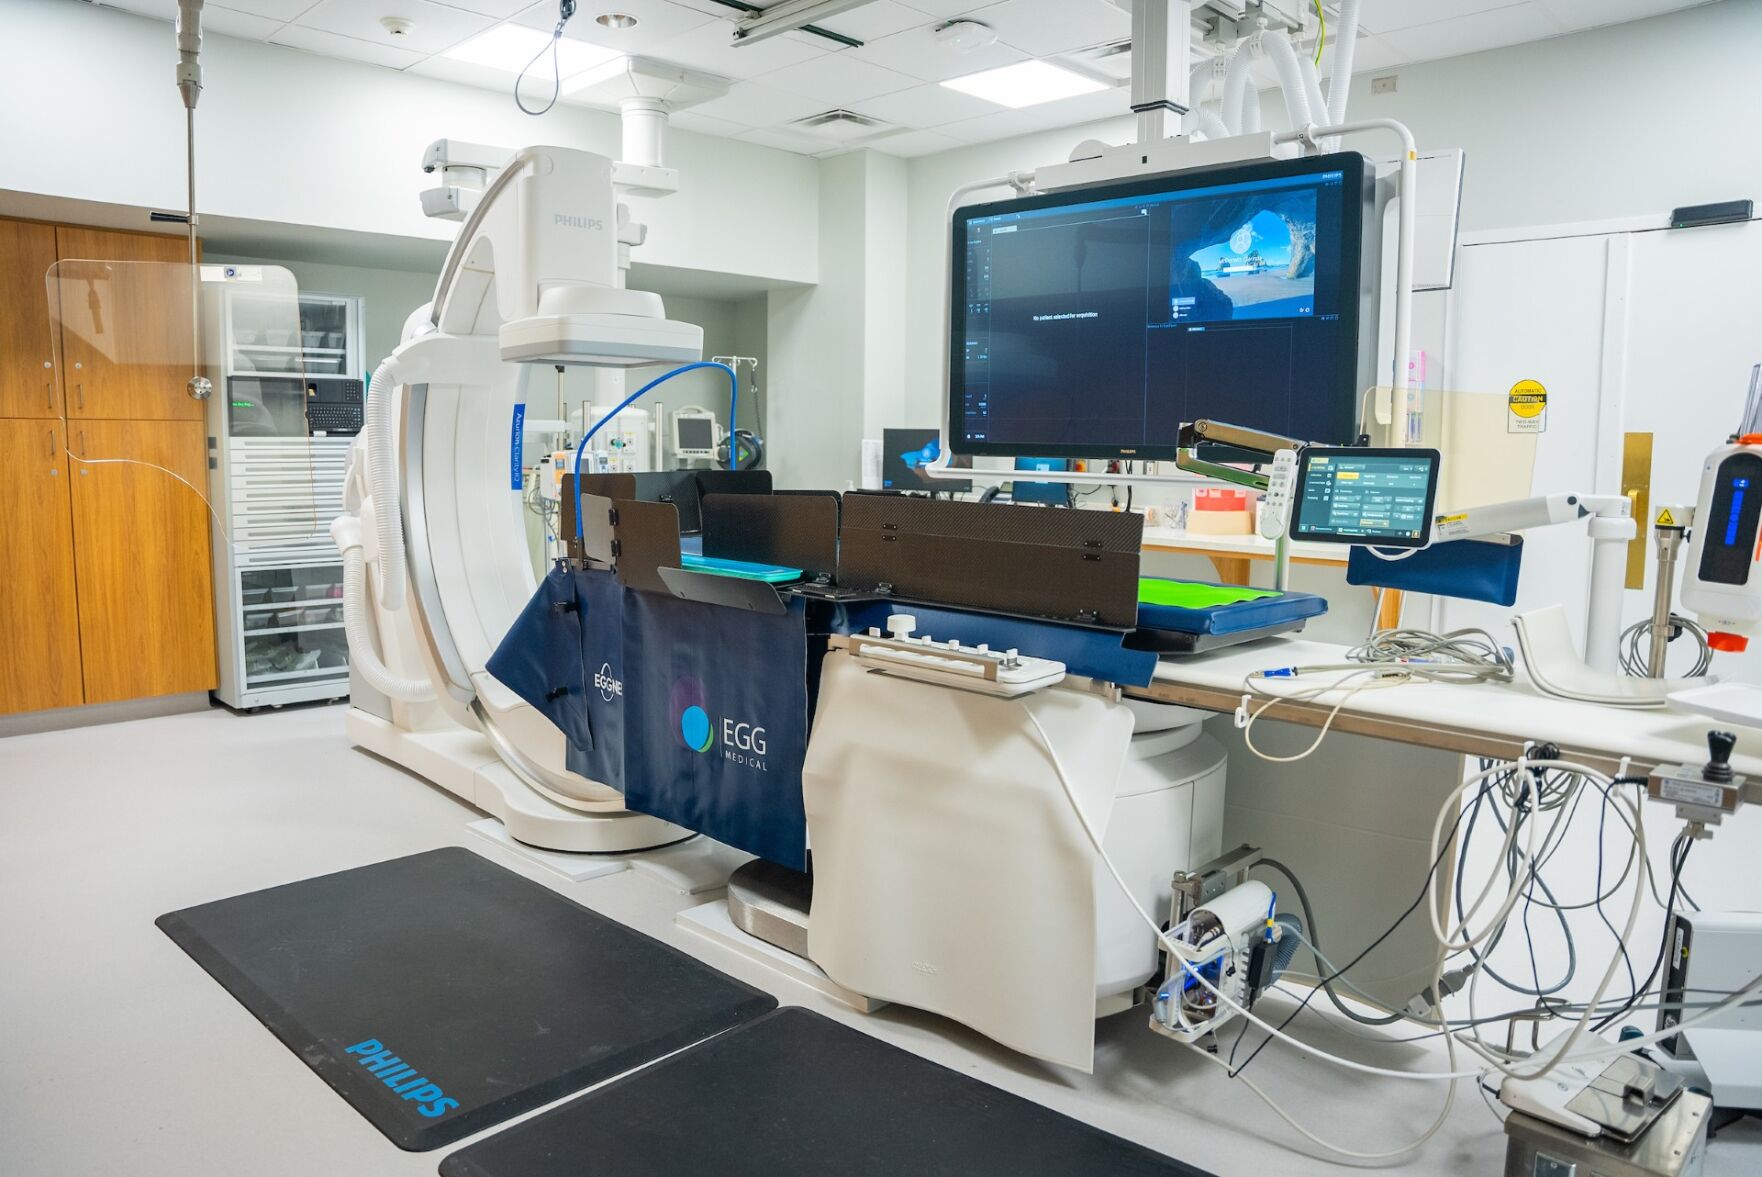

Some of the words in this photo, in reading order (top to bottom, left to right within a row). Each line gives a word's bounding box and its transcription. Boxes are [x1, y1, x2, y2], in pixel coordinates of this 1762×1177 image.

[554, 214, 604, 231] PHILIPS
[514, 413, 523, 445] Azurion
[723, 717, 766, 755] EGG
[725, 750, 768, 771] MEDICAL
[344, 1038, 460, 1118] PHILIPS
